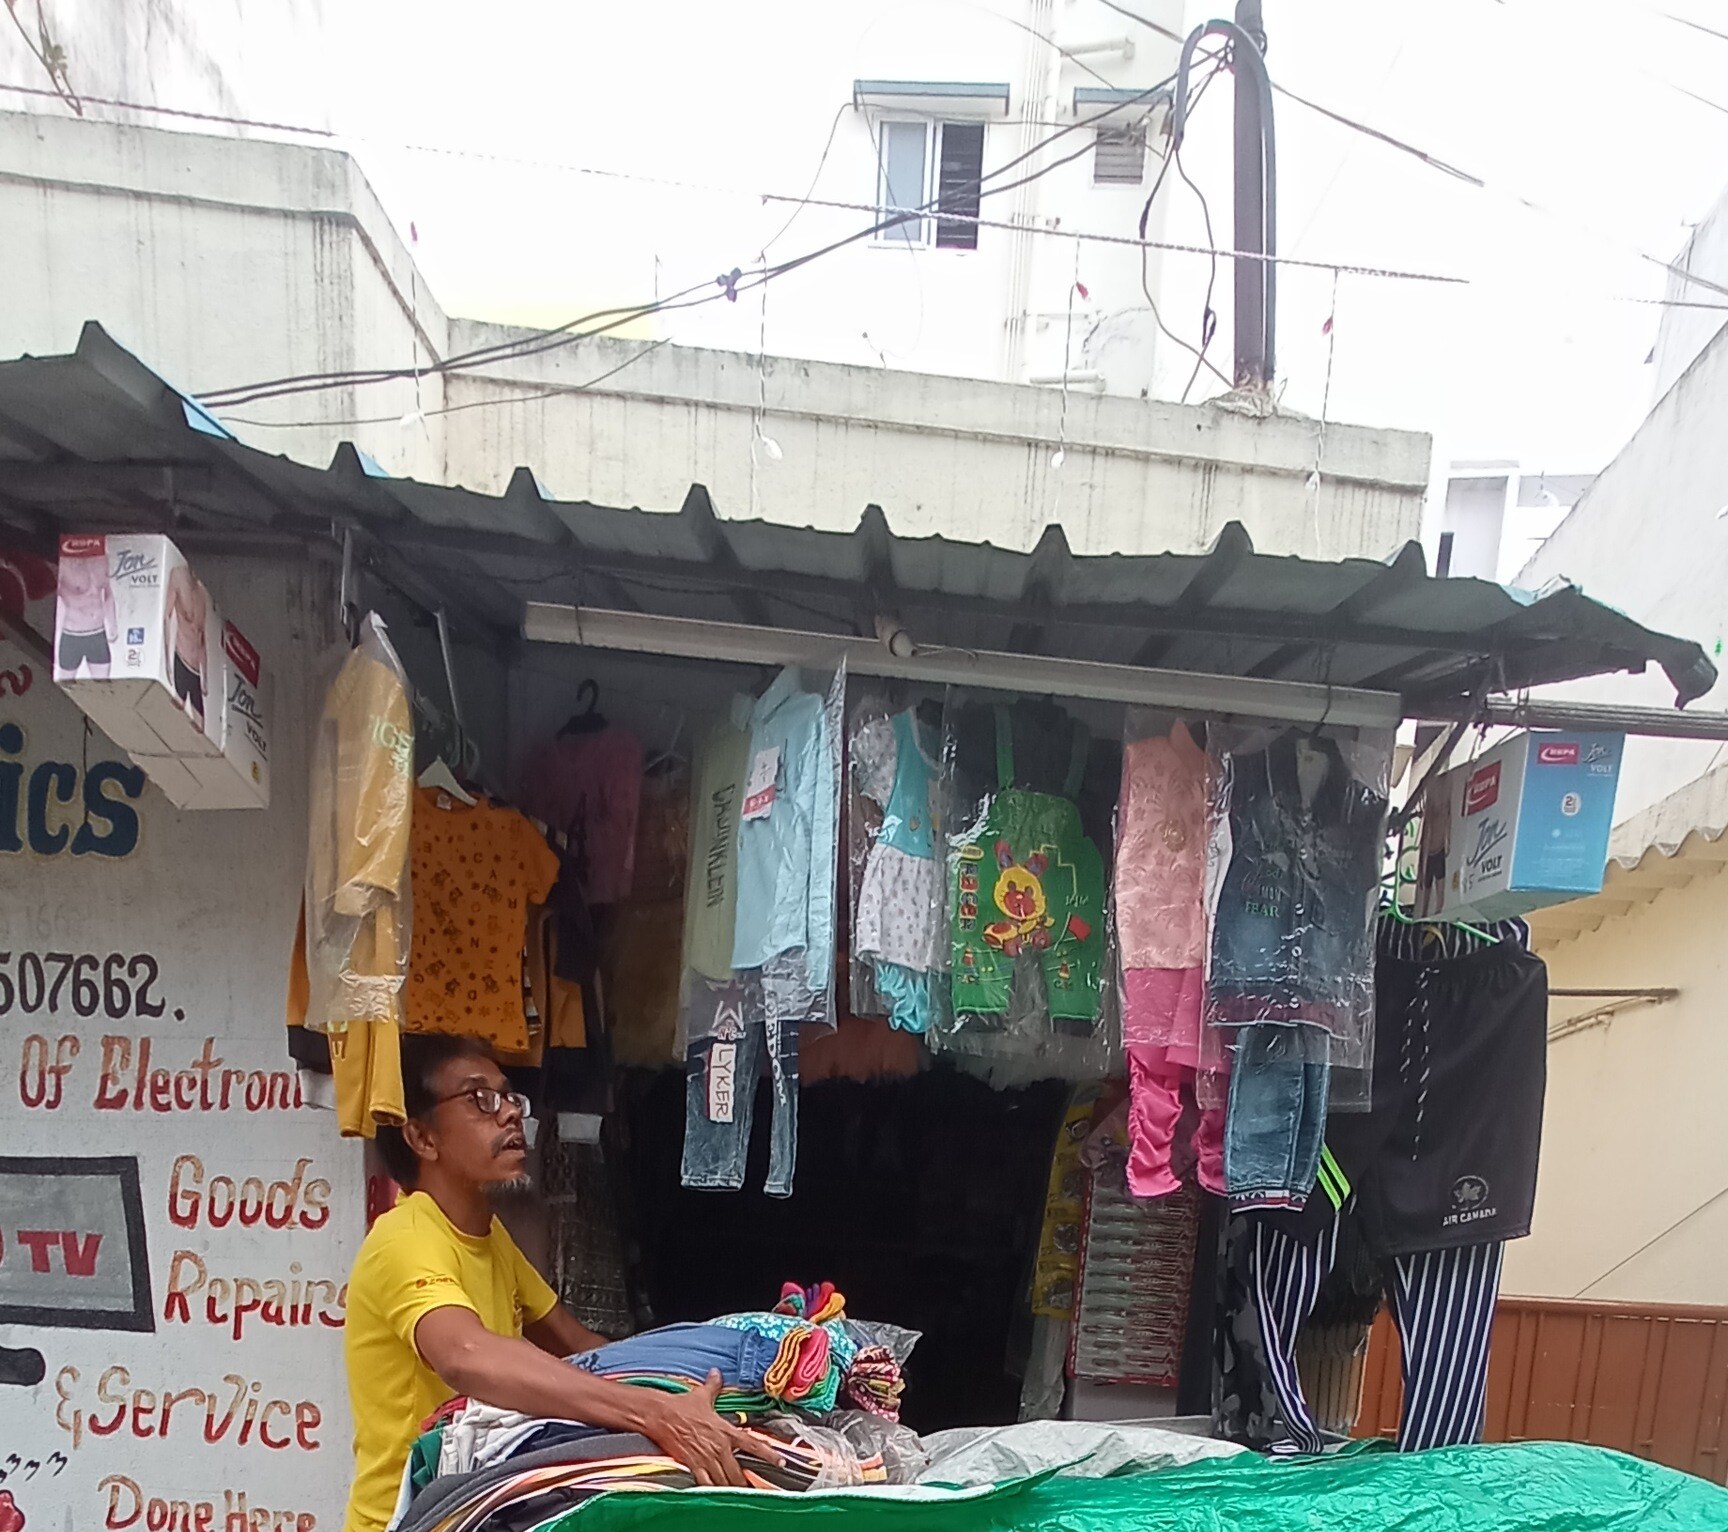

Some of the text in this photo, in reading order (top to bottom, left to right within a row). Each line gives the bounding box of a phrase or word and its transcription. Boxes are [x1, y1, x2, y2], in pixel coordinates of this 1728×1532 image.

[131, 575, 158, 584] VOLT
[1591, 765, 1612, 773] VOLT
[1481, 855, 1502, 873] VOLT
[1245, 901, 1280, 918] FEAR
[20, 1034, 80, 1109] Of
[711, 1048, 735, 1119] LYKER
[168, 1154, 332, 1231] Goods
[1443, 1215, 1458, 1227] AIR
[17, 1230, 103, 1277] TV
[164, 1250, 348, 1341] Repairs
